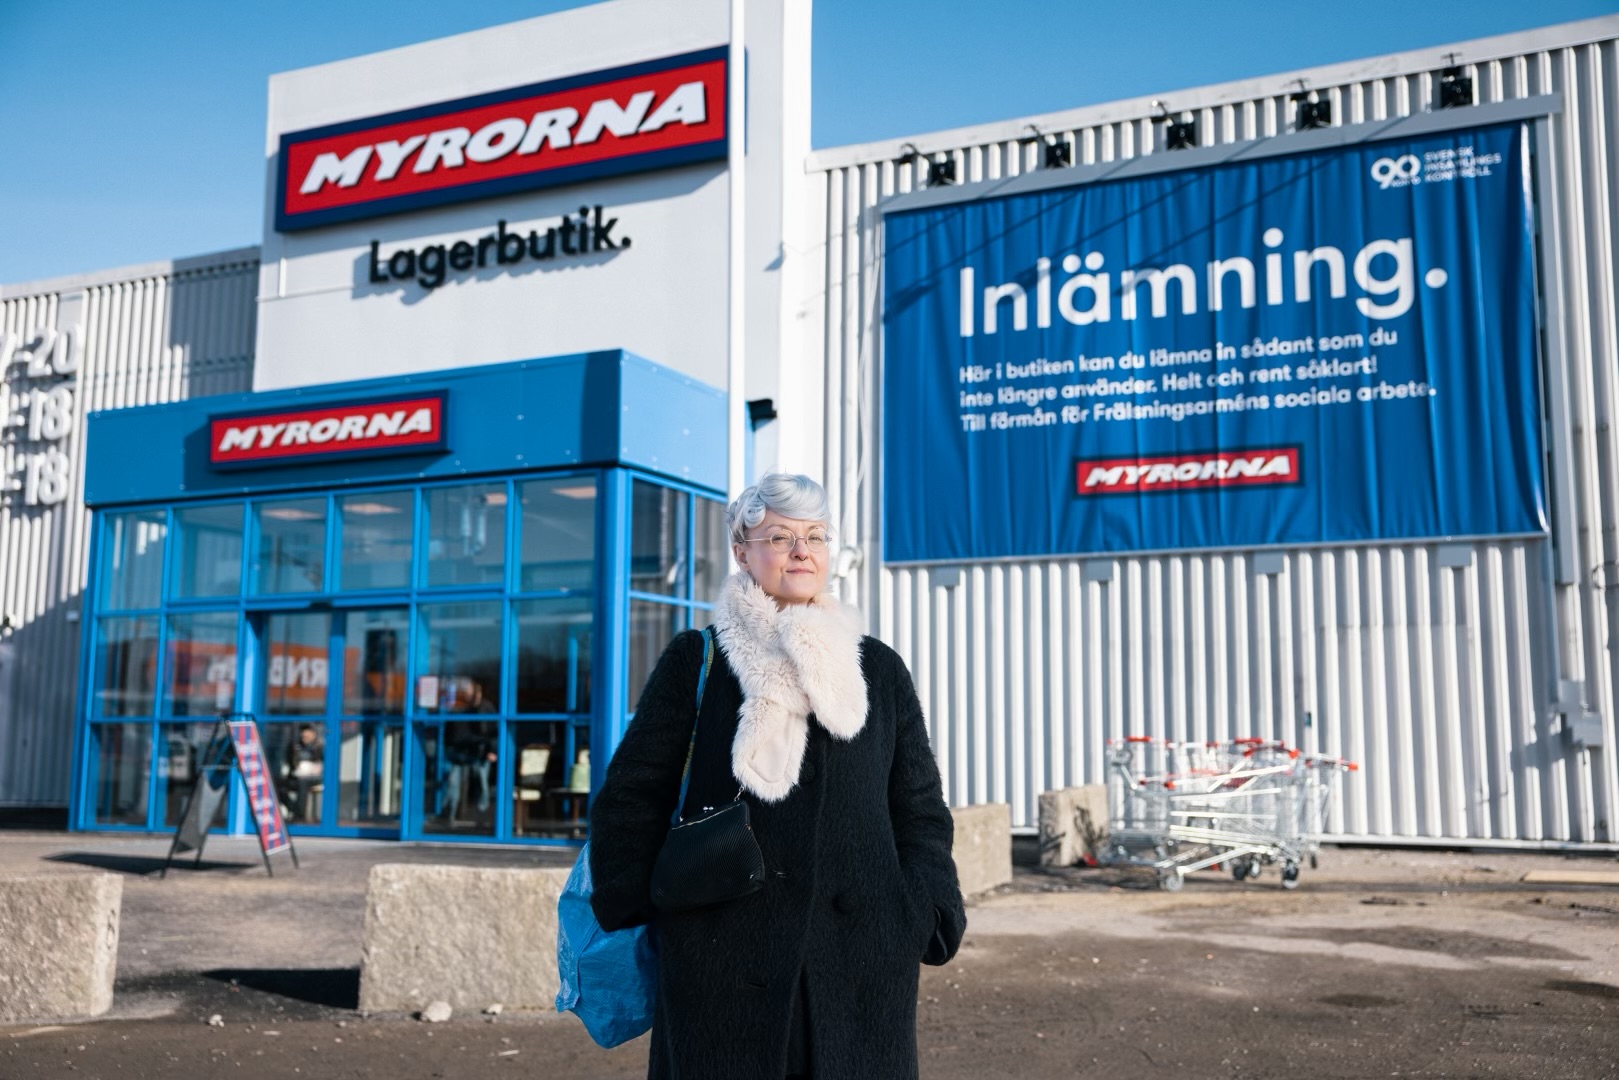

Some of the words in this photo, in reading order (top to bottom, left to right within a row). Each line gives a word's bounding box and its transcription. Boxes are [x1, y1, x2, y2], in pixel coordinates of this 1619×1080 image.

[300, 81, 706, 194] MYRORNA
[1371, 154, 1421, 189] 90
[369, 205, 632, 290] Lagerbutik.
[960, 227, 1448, 336] Inlämning.
[959, 365, 993, 384] Här
[996, 363, 1003, 380] i
[1006, 358, 1075, 380] butiken
[1079, 354, 1115, 373] kan
[1118, 351, 1146, 370] du
[1150, 348, 1212, 368] lämna
[1216, 341, 1236, 361] in
[1240, 336, 1315, 359] sådant
[1318, 332, 1364, 351] som
[1368, 327, 1398, 347] du
[959, 391, 994, 408] inte
[997, 386, 1057, 407] längre
[1061, 376, 1158, 399] använder.
[1162, 371, 1203, 391] Helt
[1206, 367, 1245, 388] och
[1249, 364, 1292, 384] rent
[1296, 355, 1378, 380] såklart!
[219, 408, 431, 452] MYRORNA
[960, 413, 987, 432] Till
[990, 406, 1057, 431] förmån
[1061, 405, 1090, 424] för
[1093, 393, 1270, 422] Frälsningsarméns
[1274, 385, 1351, 410] sociala
[1085, 455, 1290, 487] MYRORNA
